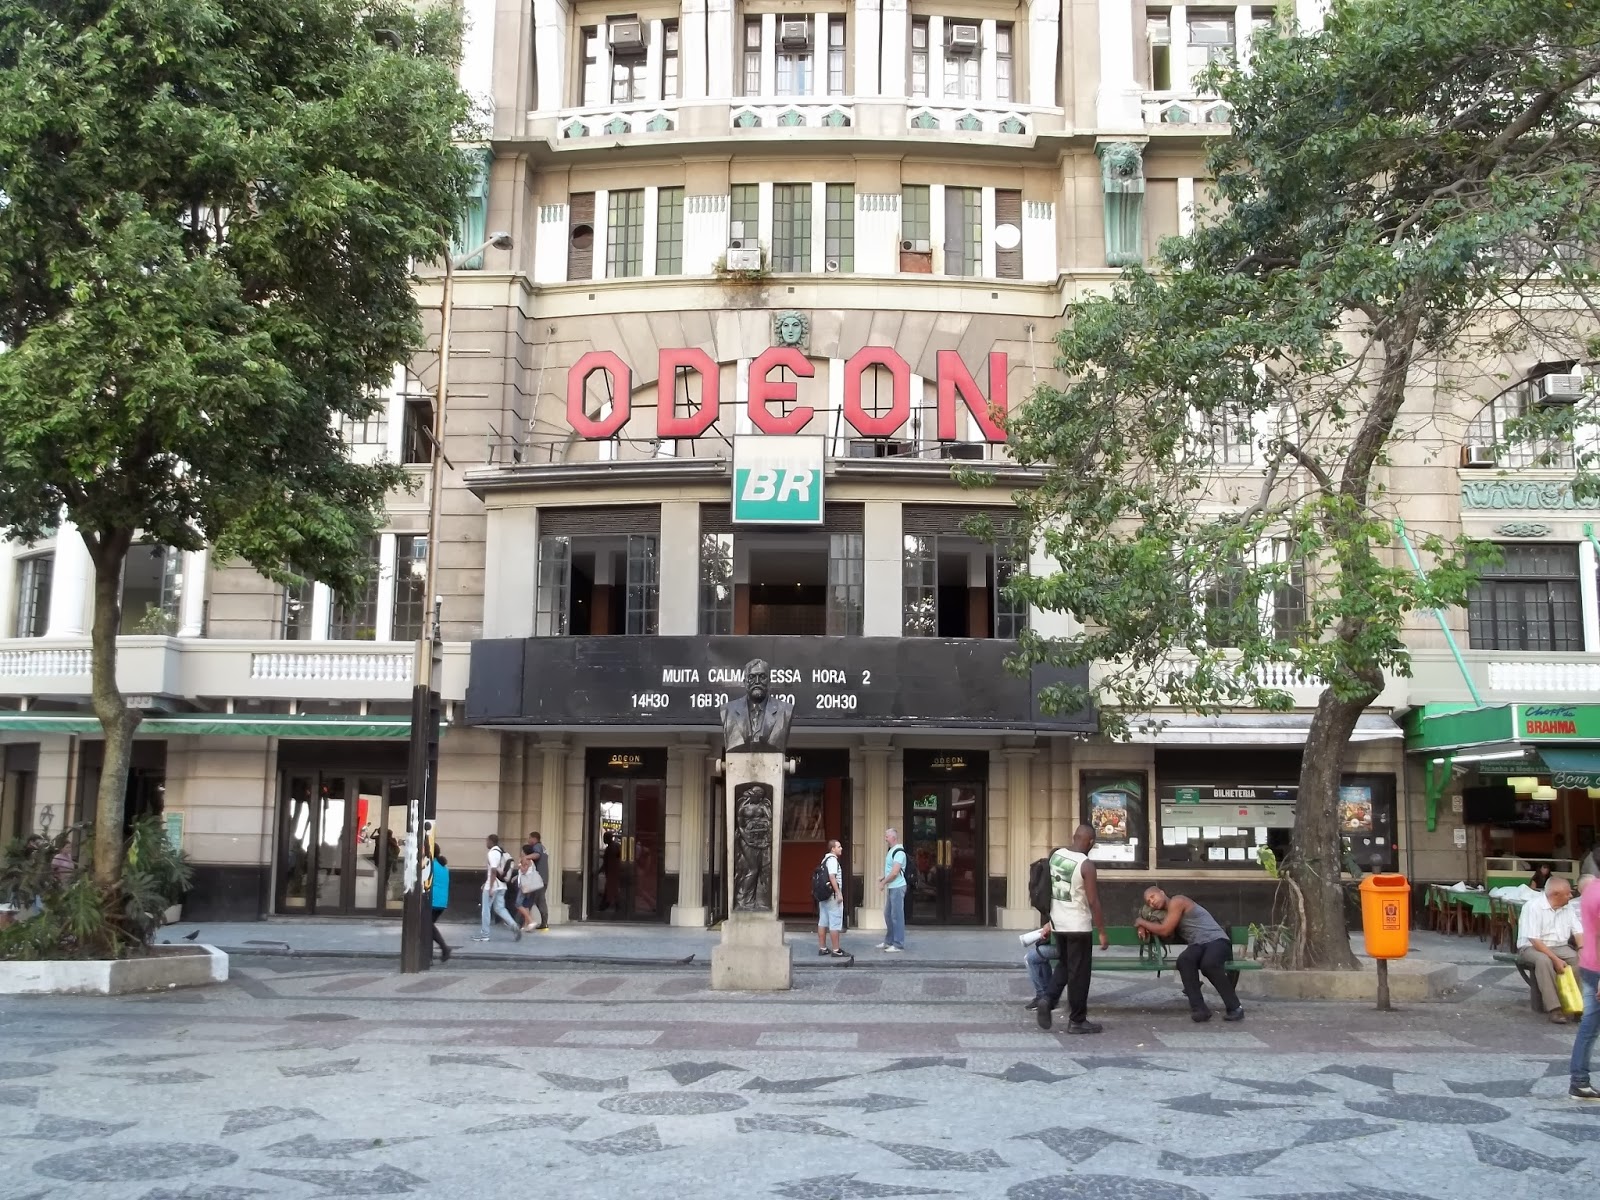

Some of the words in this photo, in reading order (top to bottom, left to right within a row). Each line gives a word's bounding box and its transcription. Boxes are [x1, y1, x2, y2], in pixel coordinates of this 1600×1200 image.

[566, 345, 1008, 443] ODEON
[741, 469, 813, 502] BR
[662, 669, 700, 683] MUITA
[770, 669, 802, 683] ESSA
[812, 669, 847, 684] HORA
[862, 670, 871, 685] 2
[631, 693, 670, 708] 14H30
[690, 693, 729, 707] 16H30
[816, 694, 857, 709] 20H30
[1526, 720, 1577, 734] BRAHMA
[612, 754, 640, 762] ODEON
[1554, 771, 1590, 785] Bom
[1214, 789, 1256, 798] BILHETERIA
